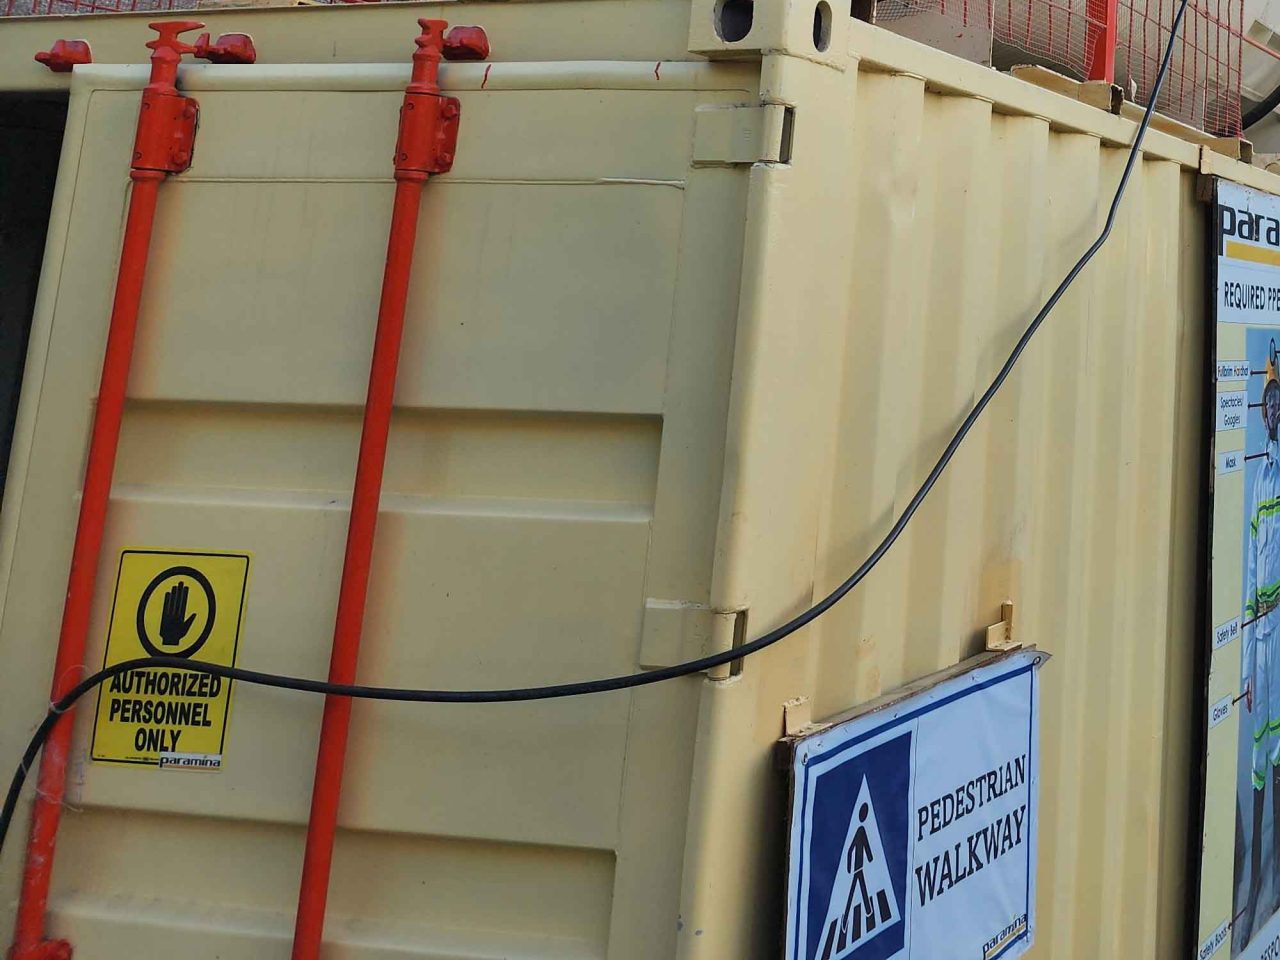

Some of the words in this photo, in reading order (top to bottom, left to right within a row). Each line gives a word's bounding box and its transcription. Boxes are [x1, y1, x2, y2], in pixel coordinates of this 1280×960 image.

[1224, 281, 1266, 311] REQUIRED
[1268, 287, 1280, 312] PPE
[109, 669, 222, 697] AUTHORIZED
[109, 698, 212, 727] PERSONNEL
[1212, 702, 1228, 722] Gloves
[134, 728, 182, 753] ONLY
[159, 755, 221, 768] paramina
[917, 754, 1026, 842] PEDESTRIAN
[915, 804, 1026, 908] WALKWAY
[982, 913, 1027, 960] paramina
